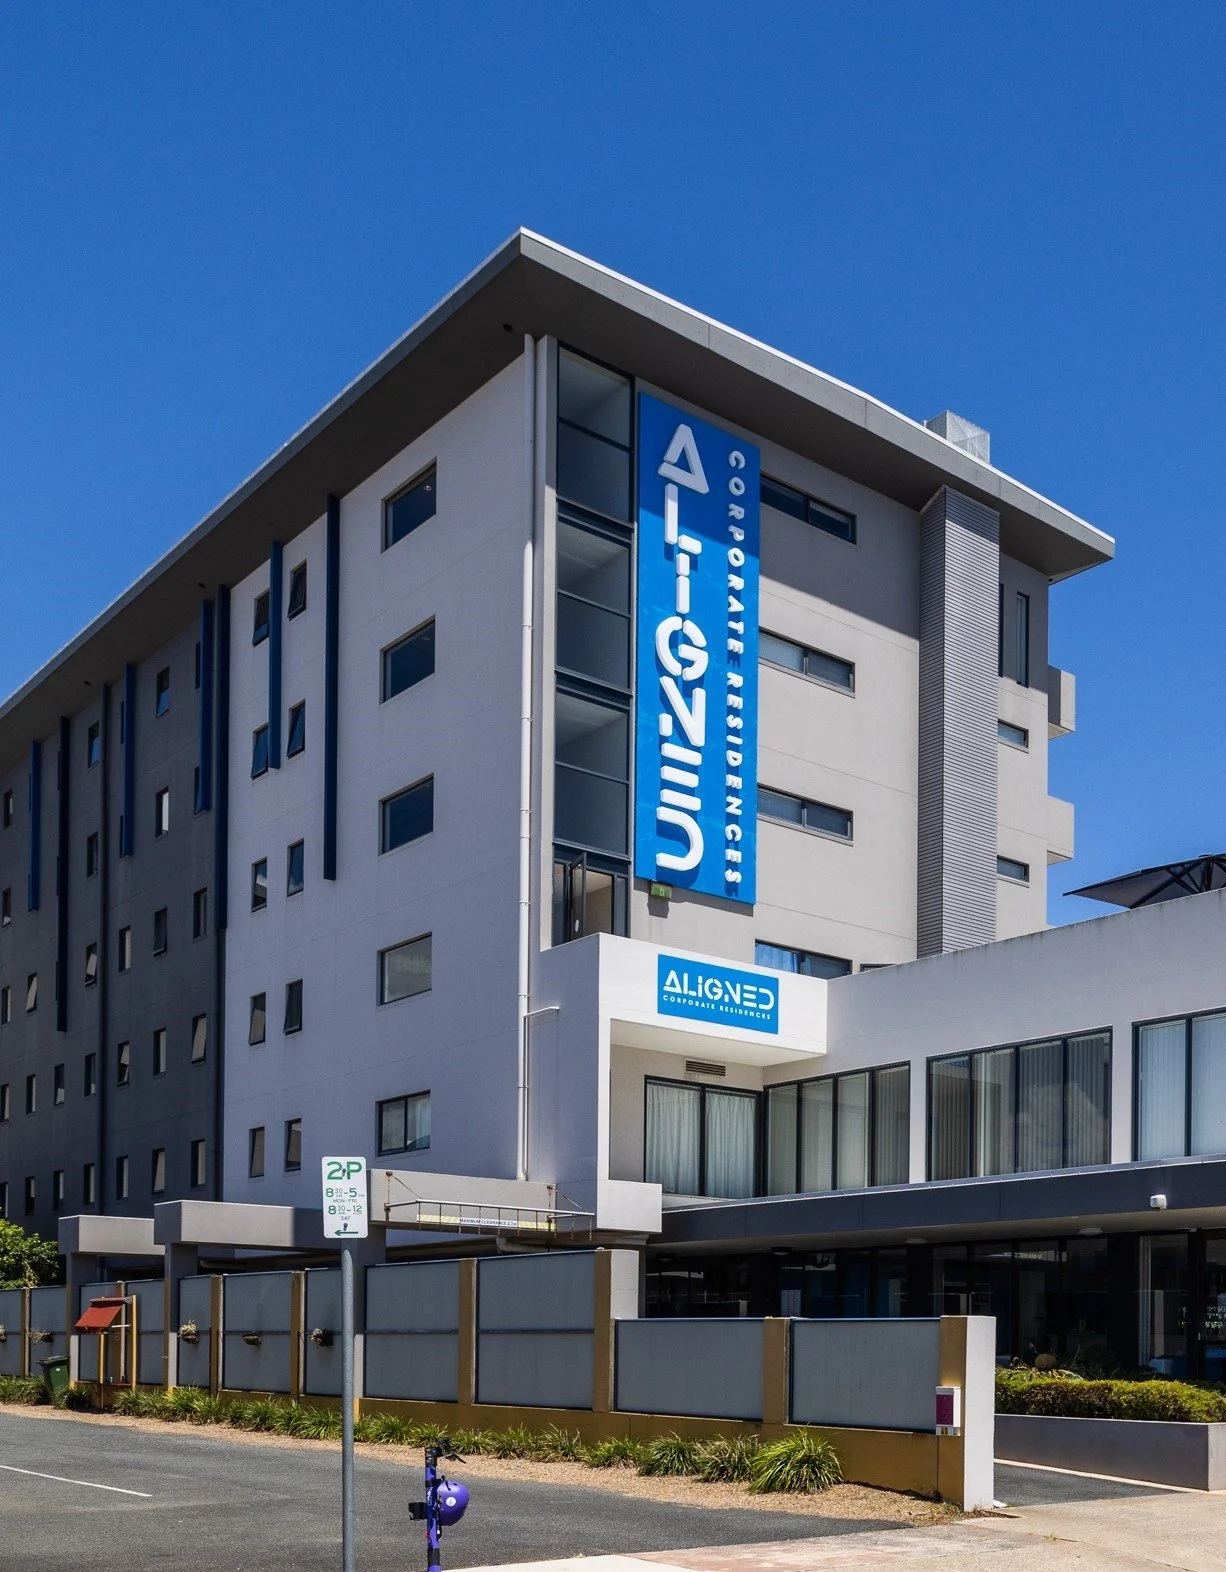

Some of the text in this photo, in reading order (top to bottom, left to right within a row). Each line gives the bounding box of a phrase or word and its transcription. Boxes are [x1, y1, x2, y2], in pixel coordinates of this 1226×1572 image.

[724, 450, 746, 884] CORPORATE RESIDENCES
[663, 994, 771, 1020] CORPORATE RESIDENCES
[327, 1161, 362, 1180] 2P
